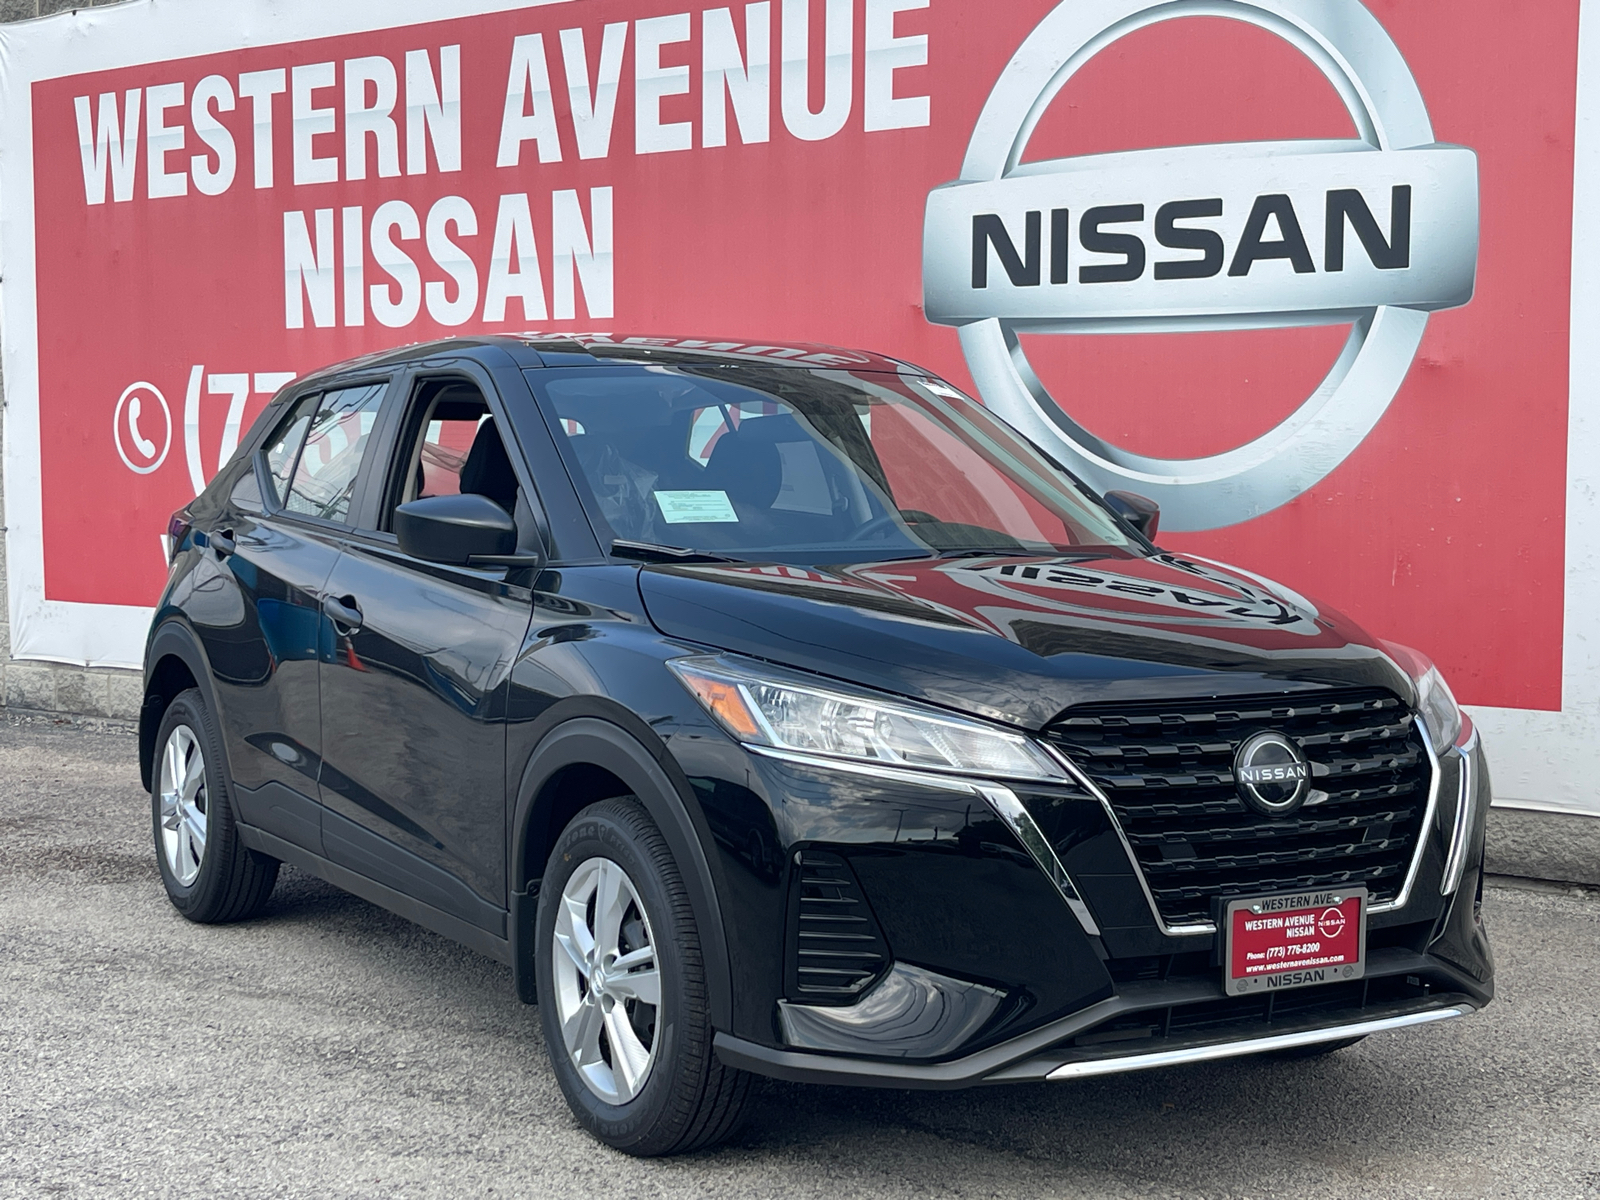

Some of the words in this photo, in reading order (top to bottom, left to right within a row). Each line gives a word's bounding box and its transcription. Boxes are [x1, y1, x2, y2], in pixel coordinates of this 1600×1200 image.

[74, 44, 462, 206] WESTERN
[496, 0, 931, 168] AVENUE
[971, 184, 1412, 289] NISSAN
[283, 186, 615, 329] NISSAN
[1240, 765, 1307, 782] NISSAN
[1262, 895, 1311, 911] WESTERN
[1245, 917, 1283, 931] WESTERN
[1284, 914, 1315, 927] AVENUE
[1286, 925, 1315, 938] NISSAN
[1317, 918, 1346, 927] NISSAN
[1246, 952, 1265, 960] Phone:
[1266, 946, 1286, 960] (773)
[1287, 942, 1320, 956] 776-8200
[1246, 955, 1344, 973] www.westernavenissan.com
[1267, 969, 1325, 988] NISSAN
